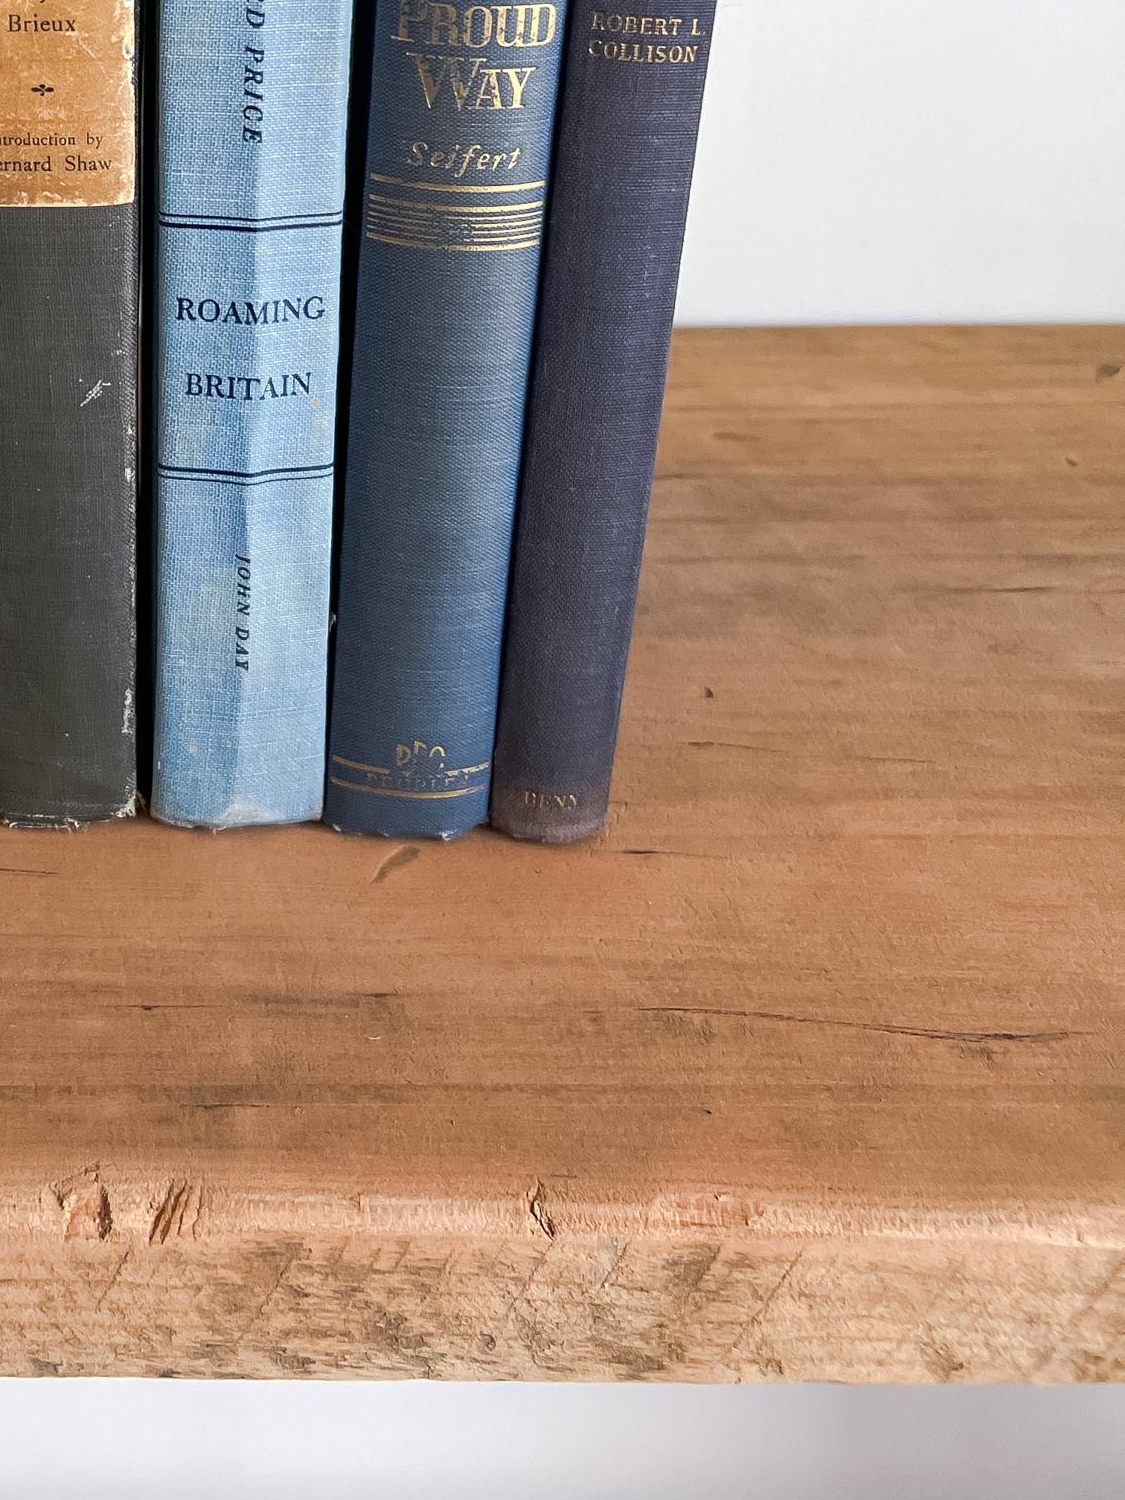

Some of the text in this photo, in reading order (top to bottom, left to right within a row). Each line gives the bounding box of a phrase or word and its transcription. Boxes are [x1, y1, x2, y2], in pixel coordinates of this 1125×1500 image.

[7, 14, 76, 33] Brieux
[590, 11, 683, 37] ROBERT
[587, 39, 699, 63] COLLISON
[242, 45, 265, 144] PRICE
[405, 51, 537, 110] WAY
[86, 132, 103, 150] by
[65, 156, 112, 172] Shaw
[406, 141, 522, 178] Seifert
[175, 296, 326, 325] ROAMING
[185, 372, 312, 400] BRITAIN
[235, 553, 251, 673] JOHN DAY
